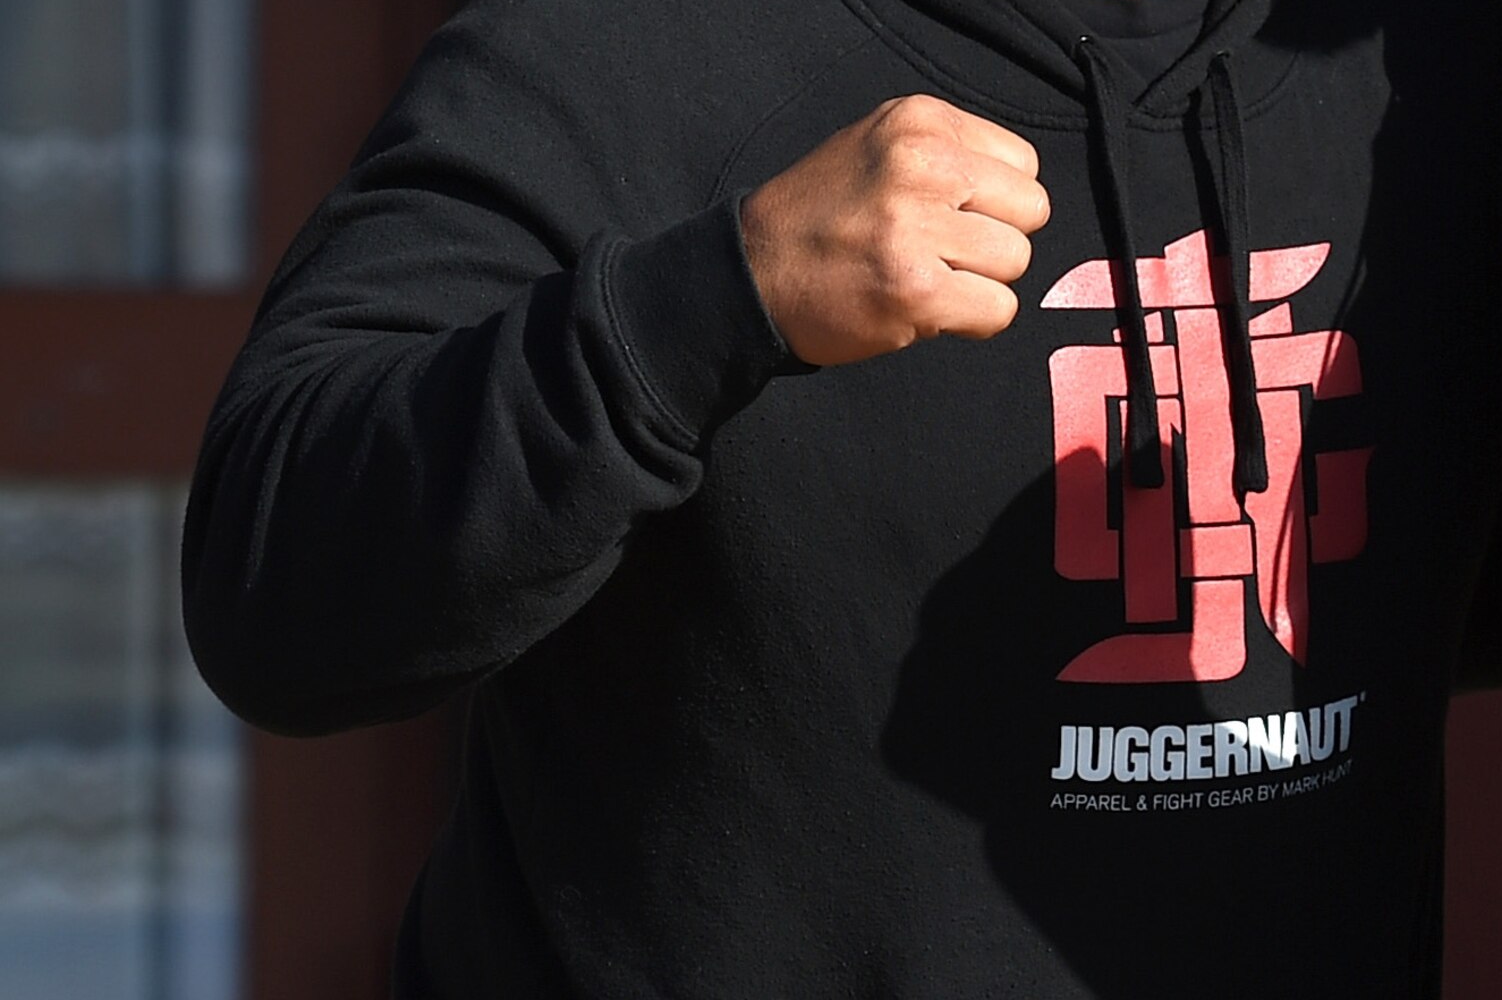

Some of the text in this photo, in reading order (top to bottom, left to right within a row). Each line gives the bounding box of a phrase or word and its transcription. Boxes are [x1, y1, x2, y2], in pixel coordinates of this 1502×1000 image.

[1051, 695, 1359, 782] JUGGERNAUT
[1050, 793, 1131, 811] APPAREL
[1136, 794, 1148, 811] &
[1153, 792, 1203, 811] FIGHT
[1208, 787, 1254, 807] GEAR
[1258, 784, 1279, 801] BY
[1282, 774, 1320, 797] MARK
